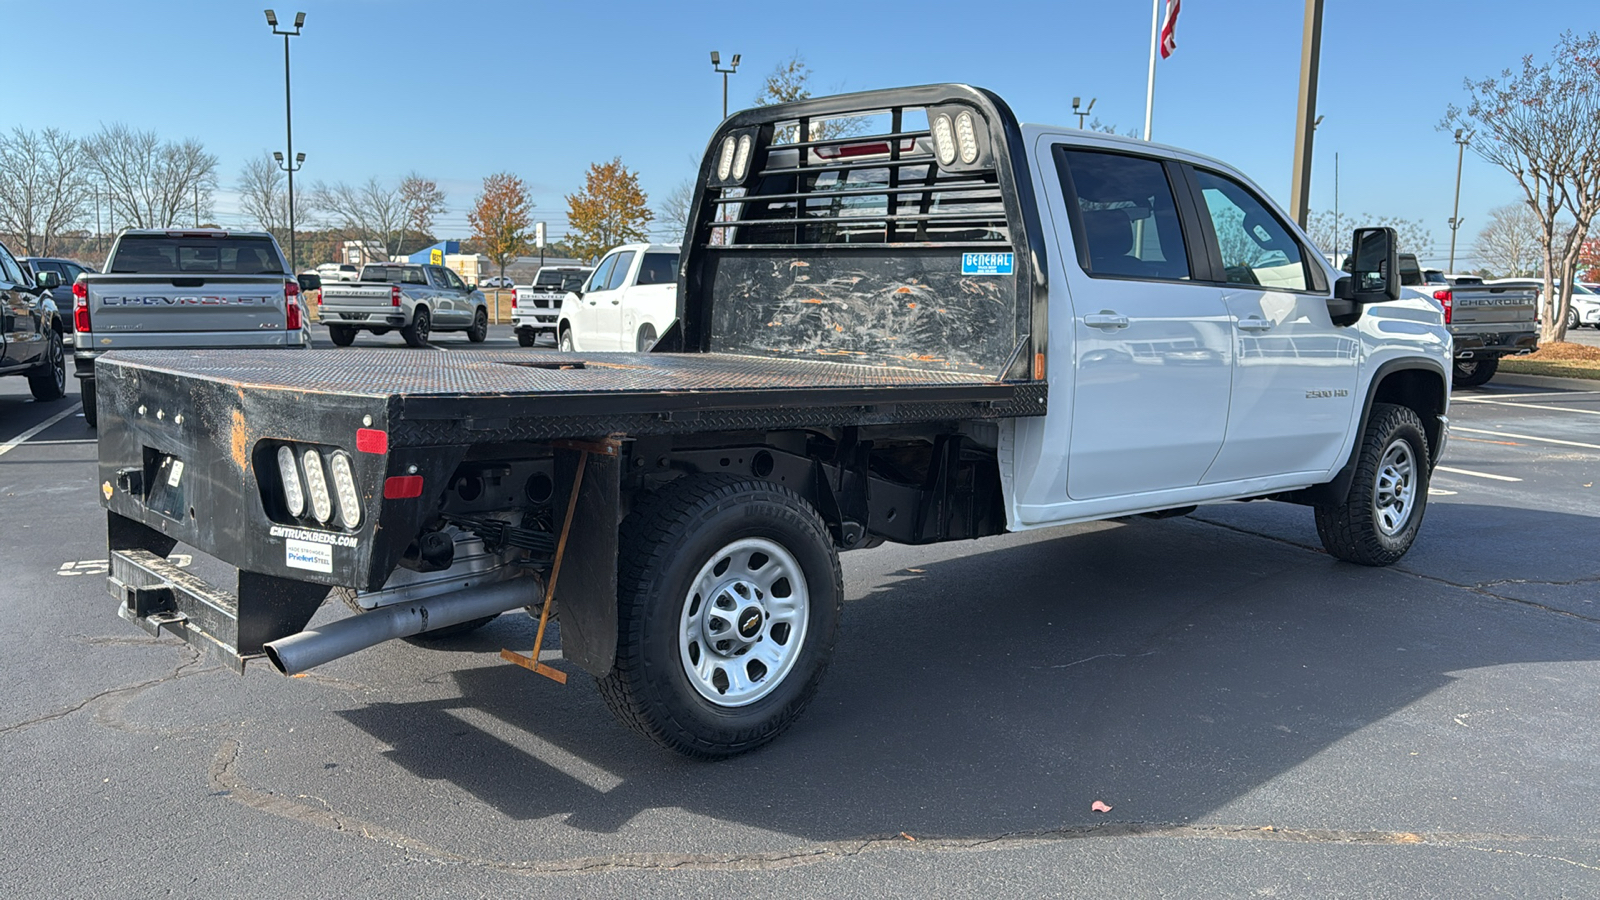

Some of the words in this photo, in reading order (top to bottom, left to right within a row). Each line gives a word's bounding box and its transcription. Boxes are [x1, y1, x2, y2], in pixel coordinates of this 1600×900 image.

[432, 253, 442, 262] BEST
[966, 254, 1010, 266] GENERAL
[103, 296, 272, 305] CHEVROLET
[1460, 298, 1533, 306] CHEVROLET
[1305, 390, 1333, 399] 2500
[1334, 389, 1349, 398] HD
[269, 526, 358, 548] CMTRUCKBEDS.COM
[1388, 526, 1414, 549] COOPER
[314, 556, 330, 565] STEEL
